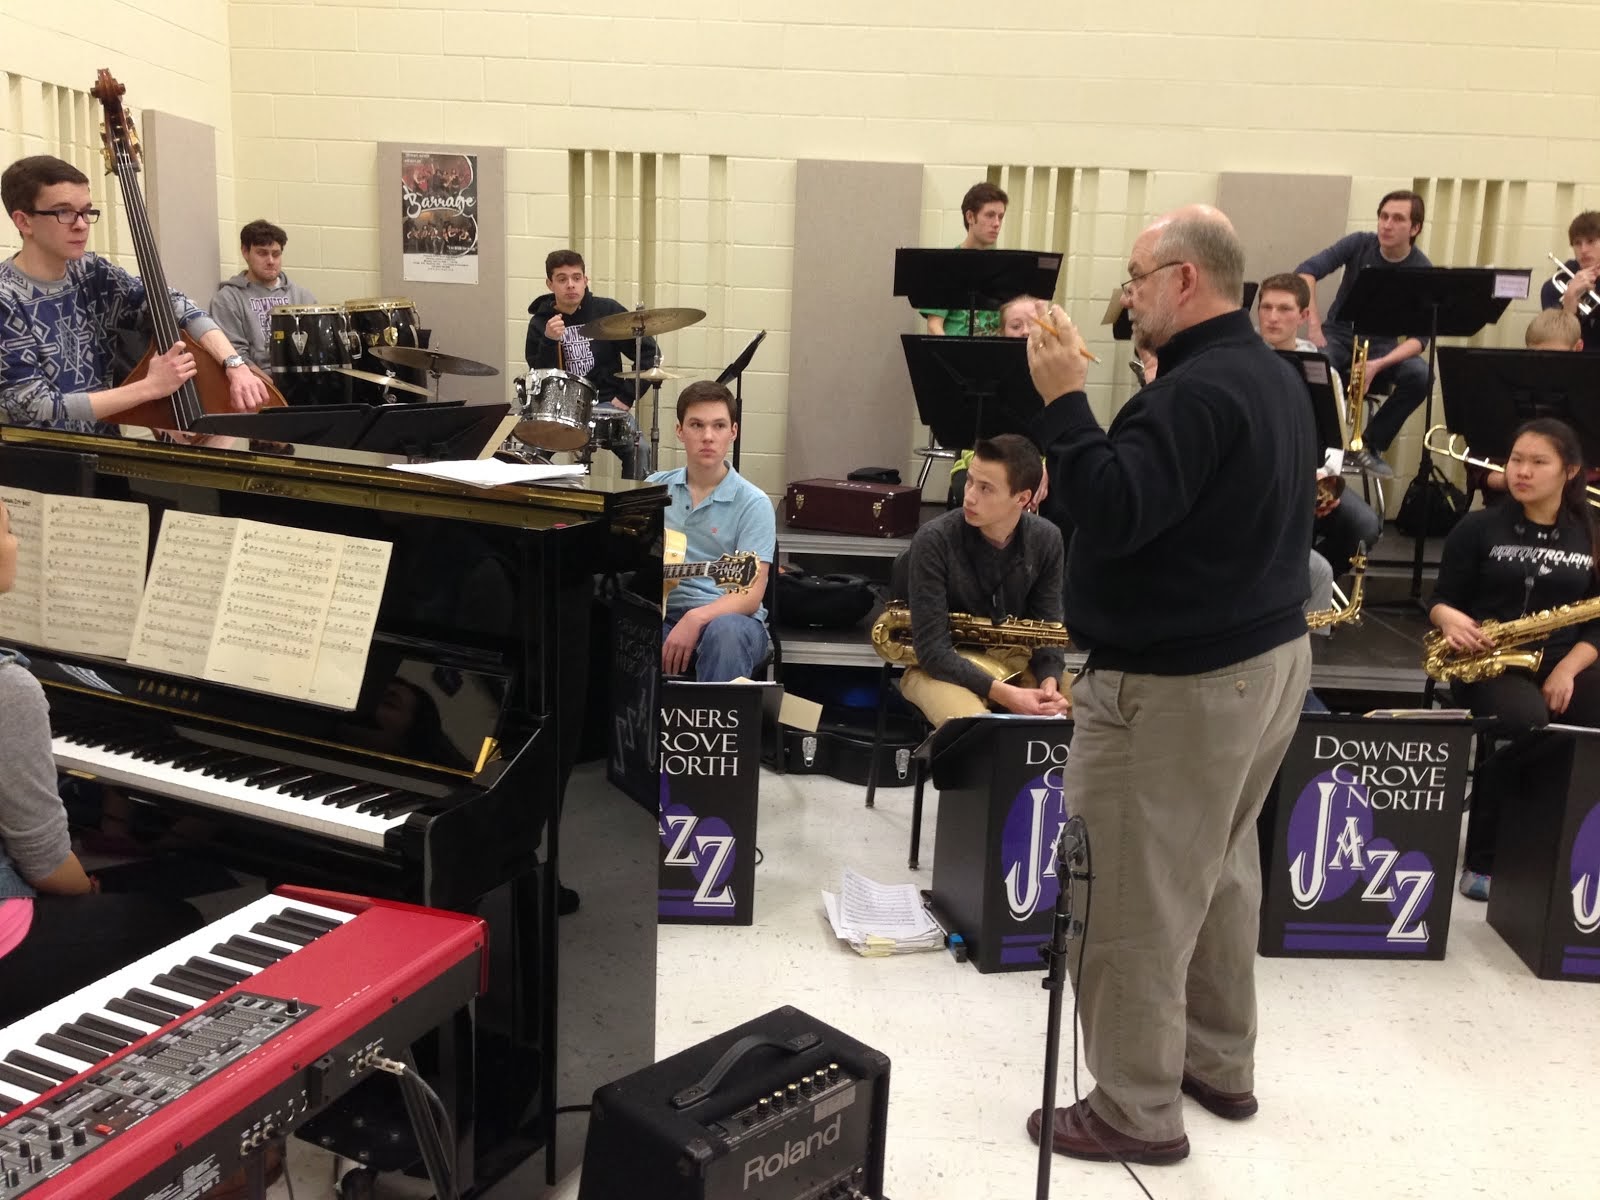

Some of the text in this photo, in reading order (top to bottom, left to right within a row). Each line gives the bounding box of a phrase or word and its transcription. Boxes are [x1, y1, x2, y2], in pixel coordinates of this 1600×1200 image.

[403, 185, 477, 218] Barrage
[660, 708, 739, 728] WNERS
[661, 732, 738, 753] ROVE
[1314, 735, 1449, 762] DOWNERS
[660, 753, 738, 776] ORTH
[1332, 762, 1446, 787] GROVE
[1346, 786, 1445, 811] NORTH
[1289, 782, 1435, 942] JAZZ
[743, 1114, 841, 1191] Roland
